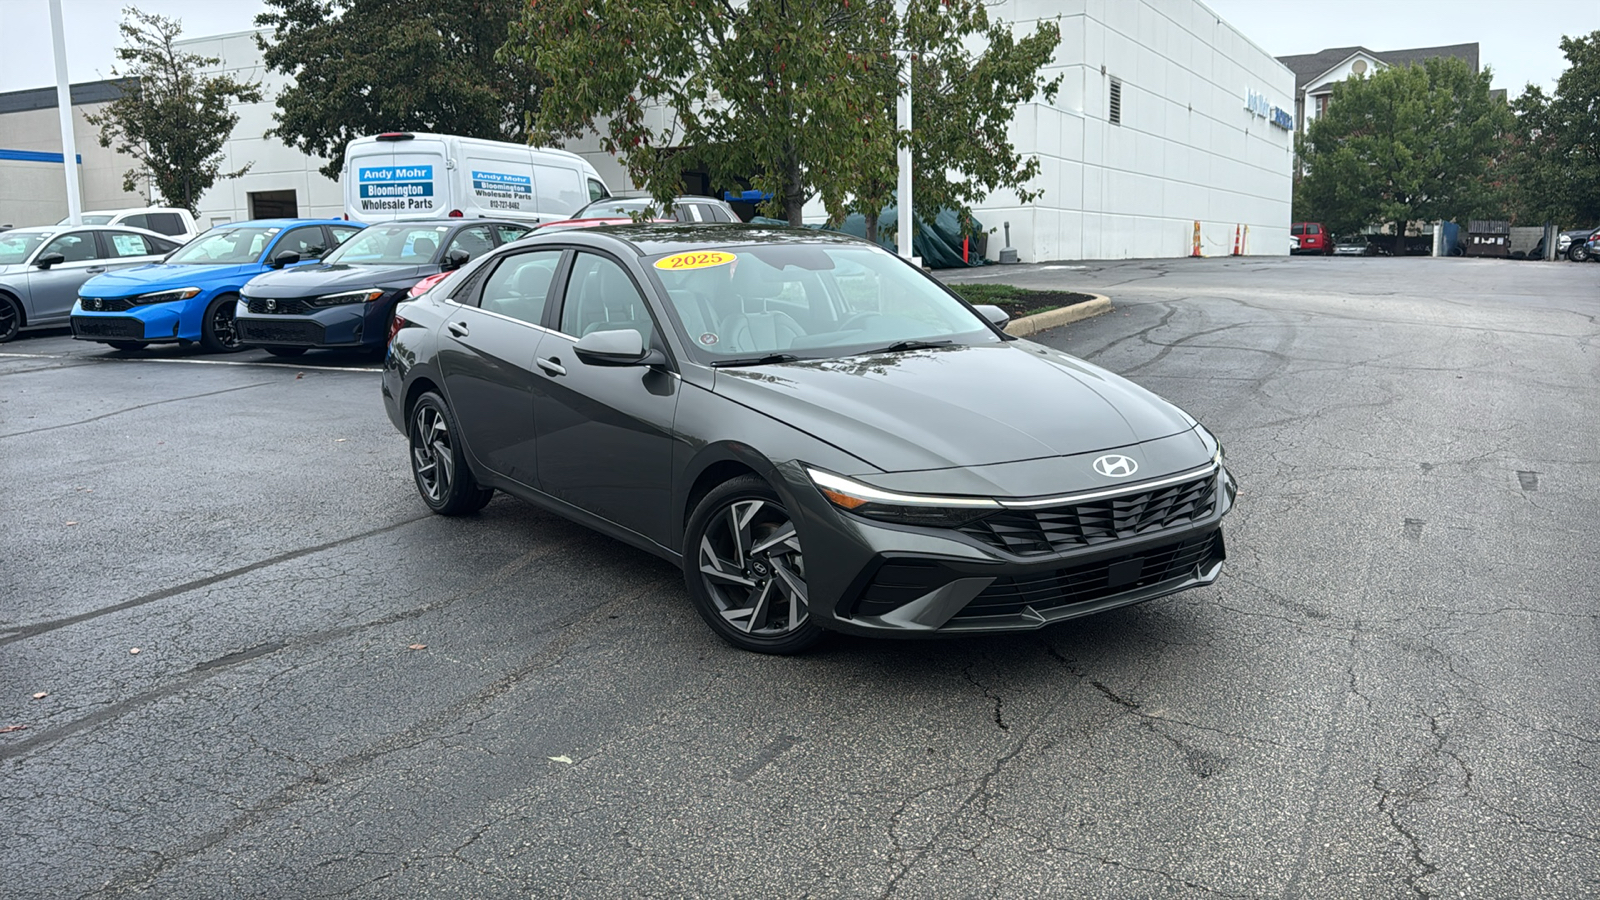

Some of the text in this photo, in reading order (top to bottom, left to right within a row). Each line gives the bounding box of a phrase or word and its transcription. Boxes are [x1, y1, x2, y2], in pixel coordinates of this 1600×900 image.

[364, 168, 427, 179] Andy Mohr
[477, 172, 527, 183] Andy Mohr
[368, 184, 423, 197] Bloomington
[481, 181, 525, 192] Bloomington
[475, 189, 532, 201] Wholesale Parts
[361, 198, 433, 210] Wholesale Parts
[671, 253, 723, 268] 2025
